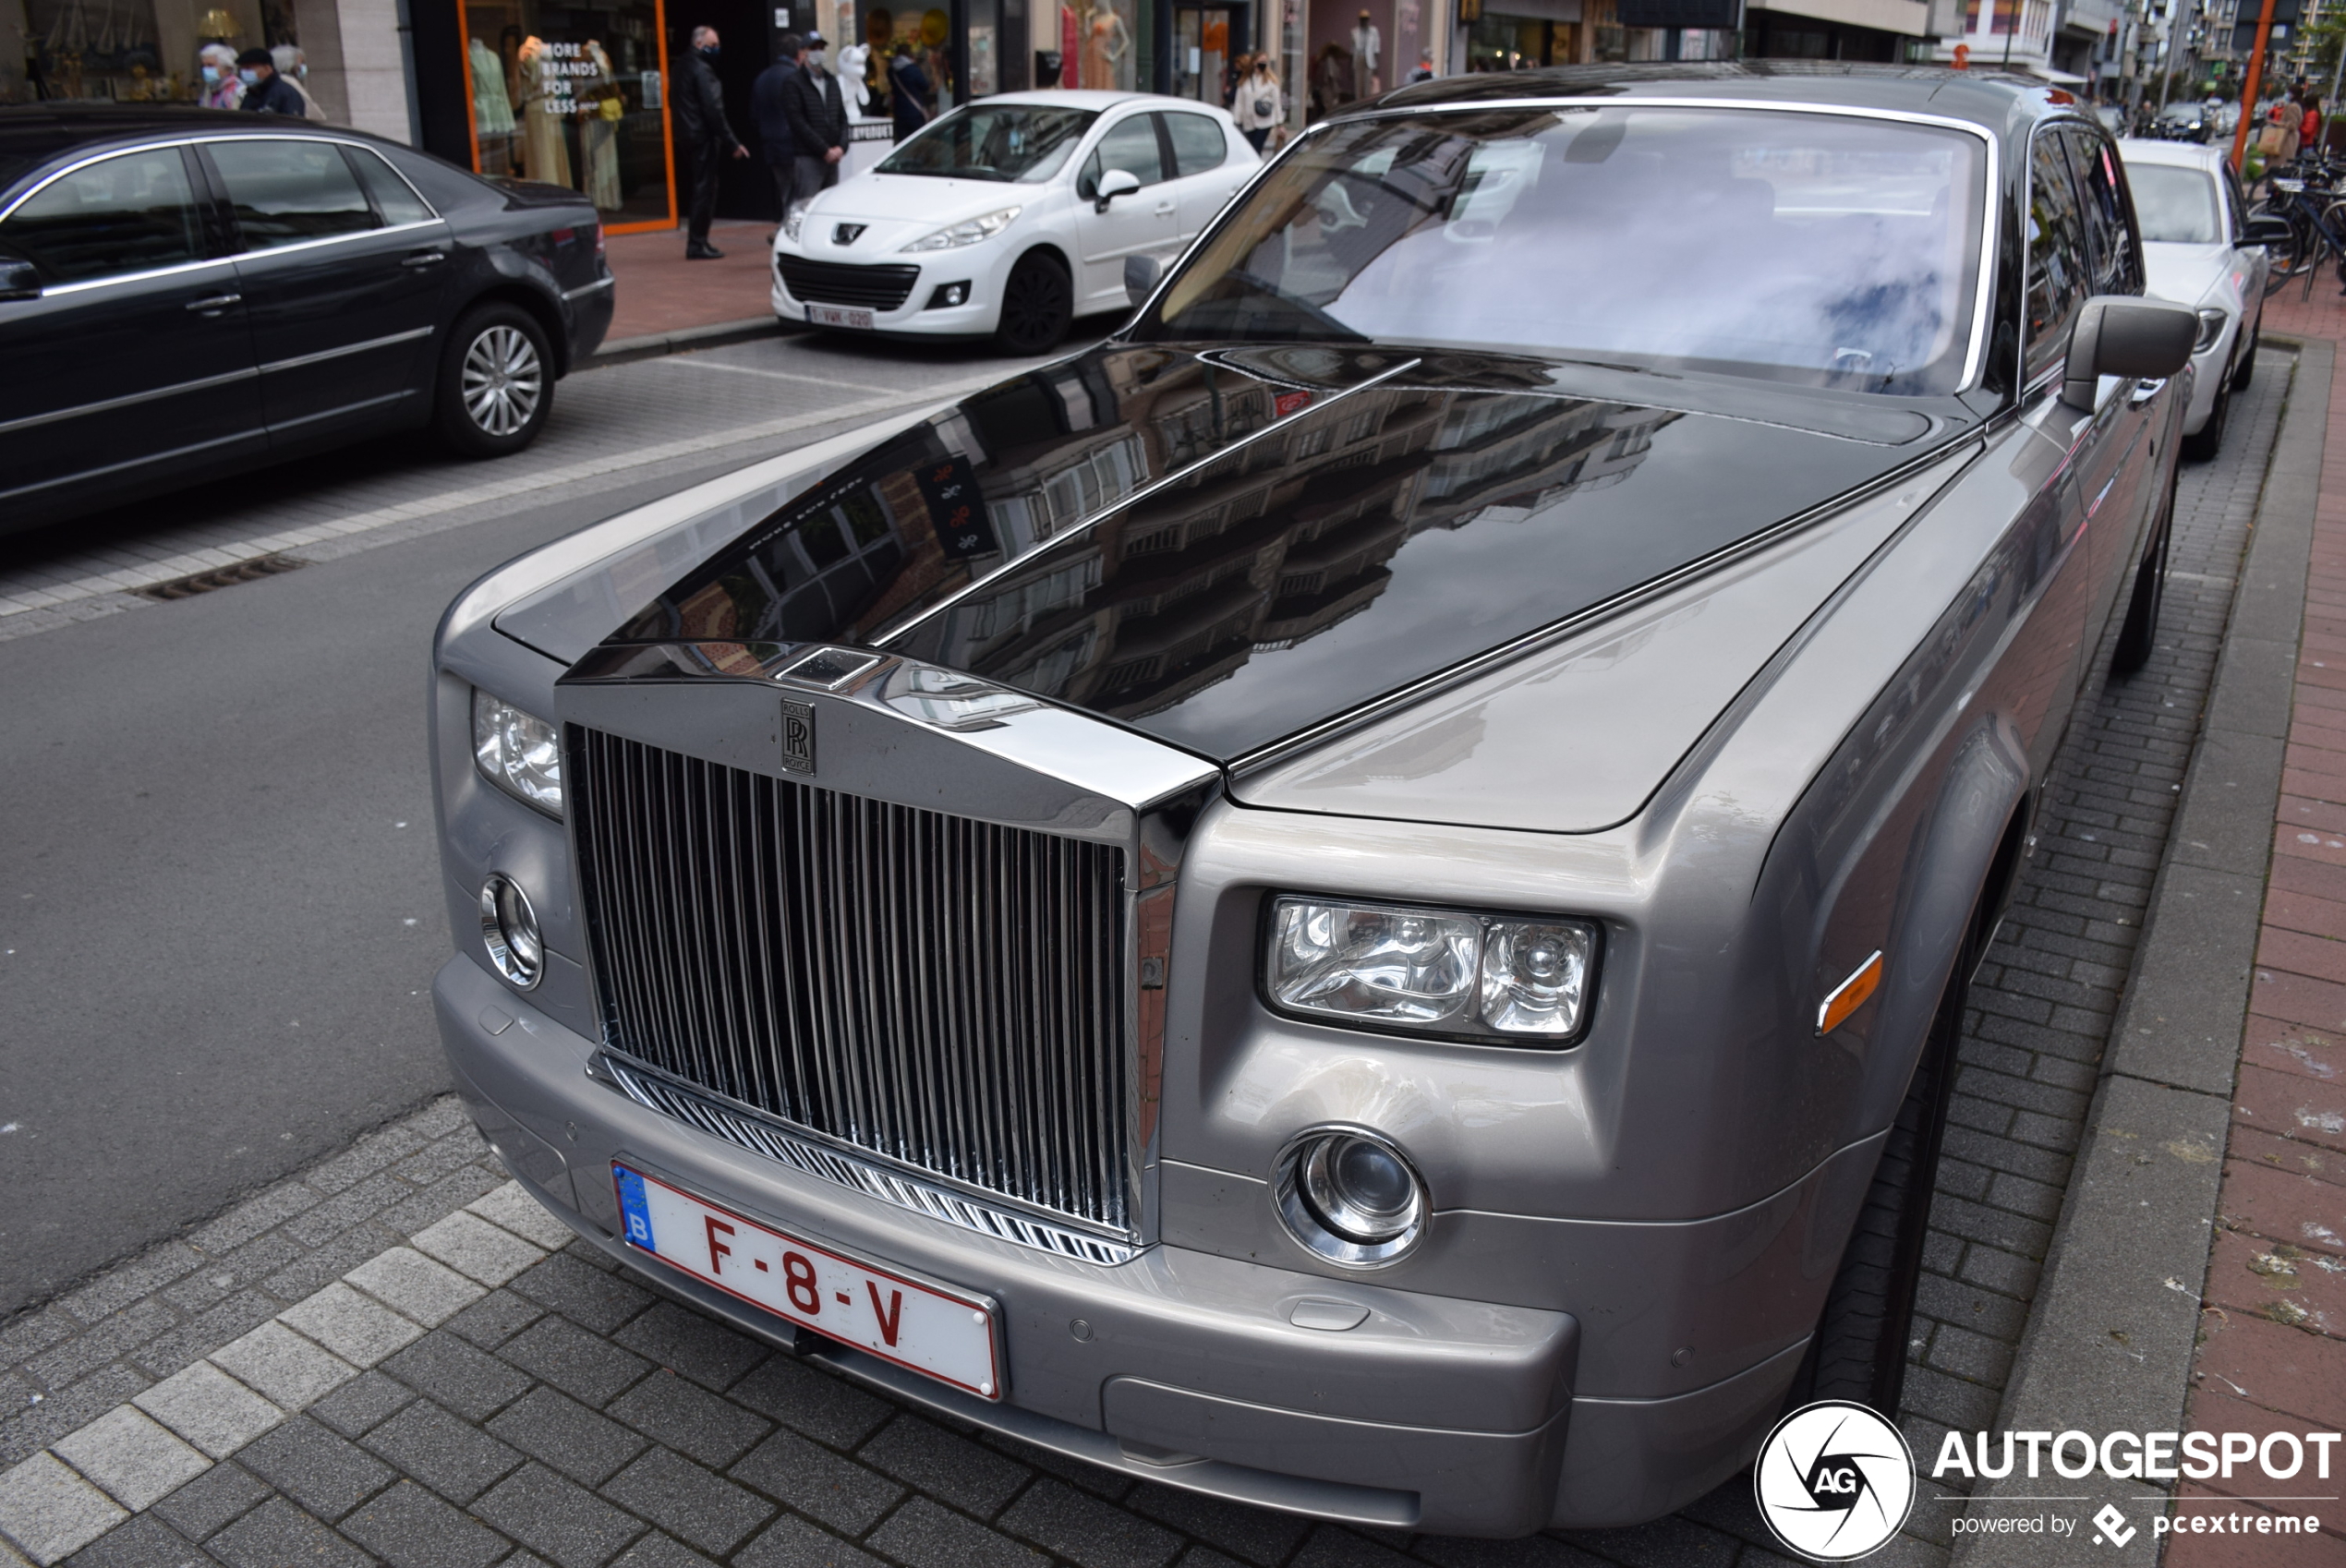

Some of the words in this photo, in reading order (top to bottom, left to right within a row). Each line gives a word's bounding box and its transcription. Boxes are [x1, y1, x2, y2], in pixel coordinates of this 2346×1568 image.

[541, 42, 582, 57] MORE
[541, 62, 599, 76] BRANDS
[543, 80, 572, 94] FOR
[545, 99, 577, 114] LESS
[784, 704, 809, 717] ROLLS
[785, 757, 810, 771] ROYCE
[629, 1212, 648, 1241] B
[704, 1214, 902, 1348] F-8-V
